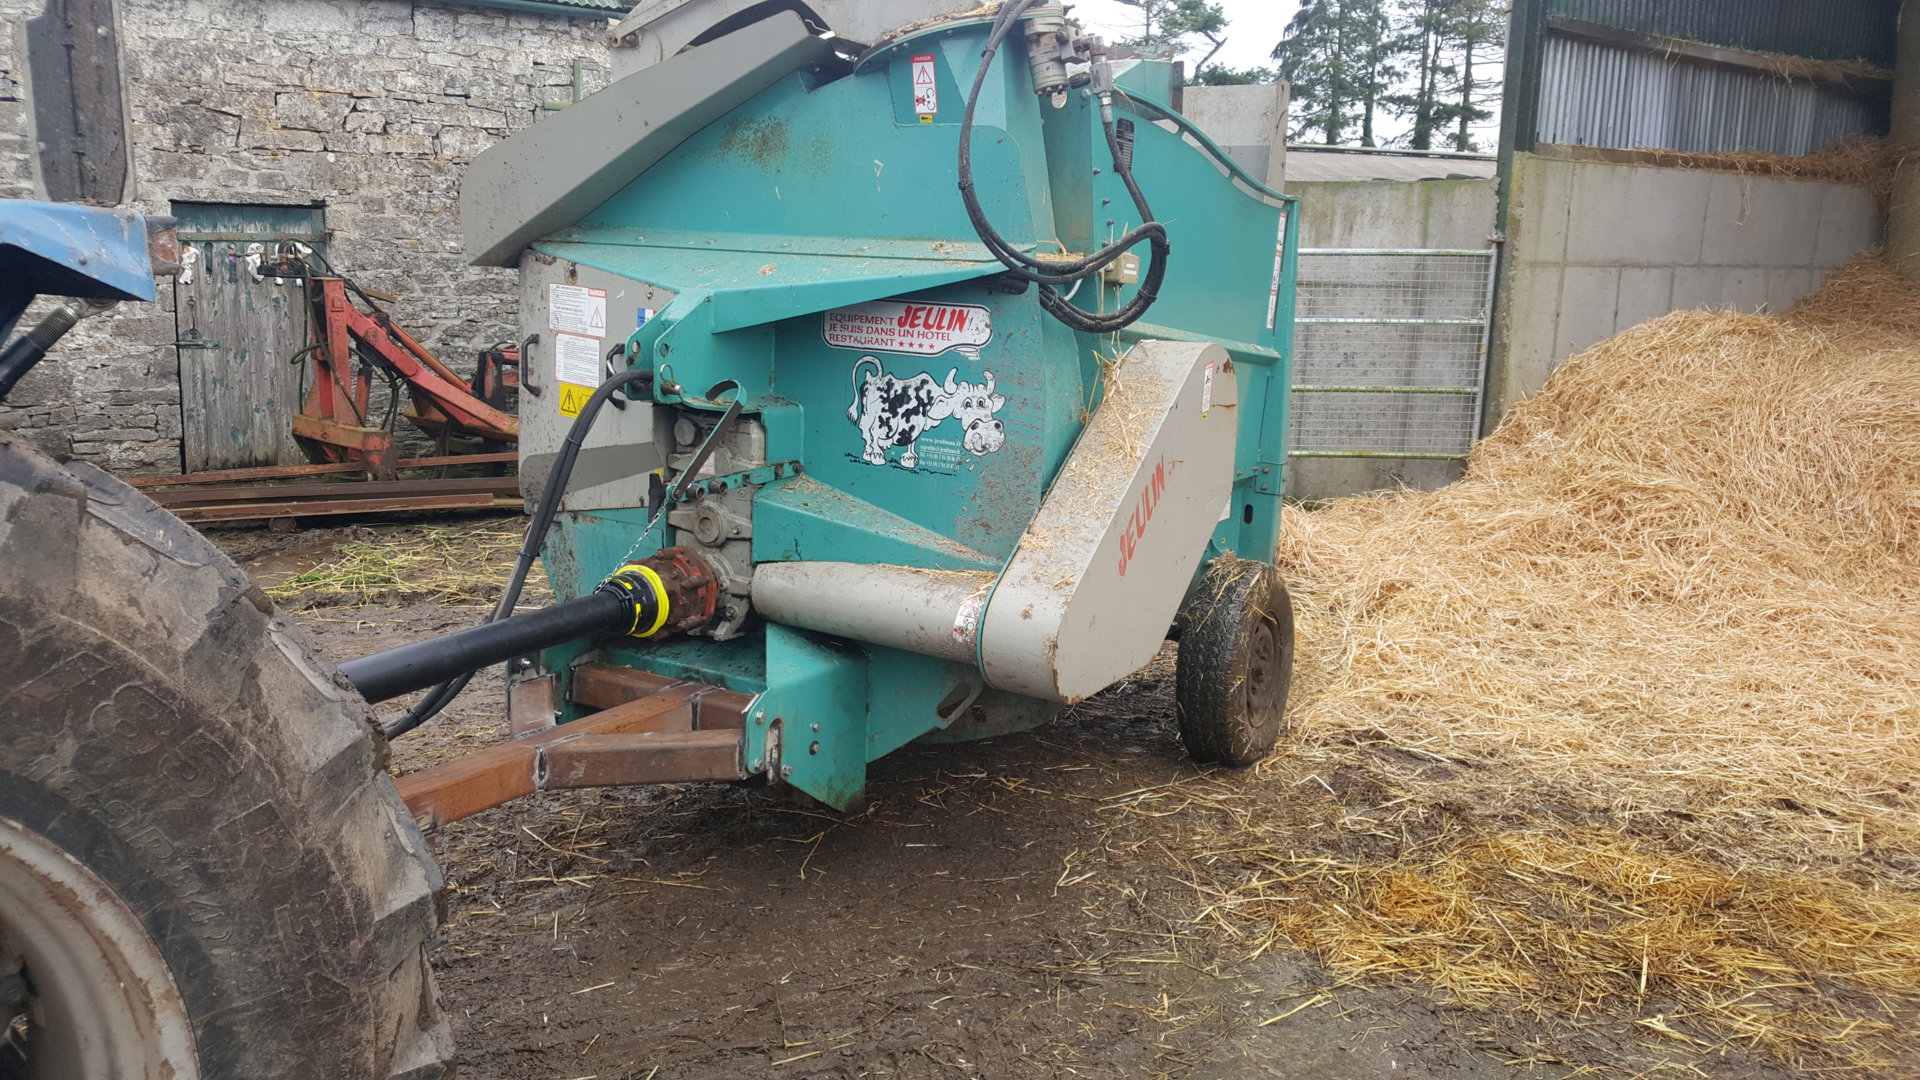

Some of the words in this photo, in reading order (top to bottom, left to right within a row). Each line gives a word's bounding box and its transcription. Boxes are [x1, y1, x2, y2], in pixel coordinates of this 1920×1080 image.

[830, 312, 895, 326] EQUIPEMENT
[828, 323, 838, 332] JE
[840, 324, 864, 334] SUIS
[866, 326, 895, 336] DANS
[898, 329, 914, 338] UN
[829, 333, 895, 347] RESTAURANT
[1118, 454, 1166, 577] JEULIN
